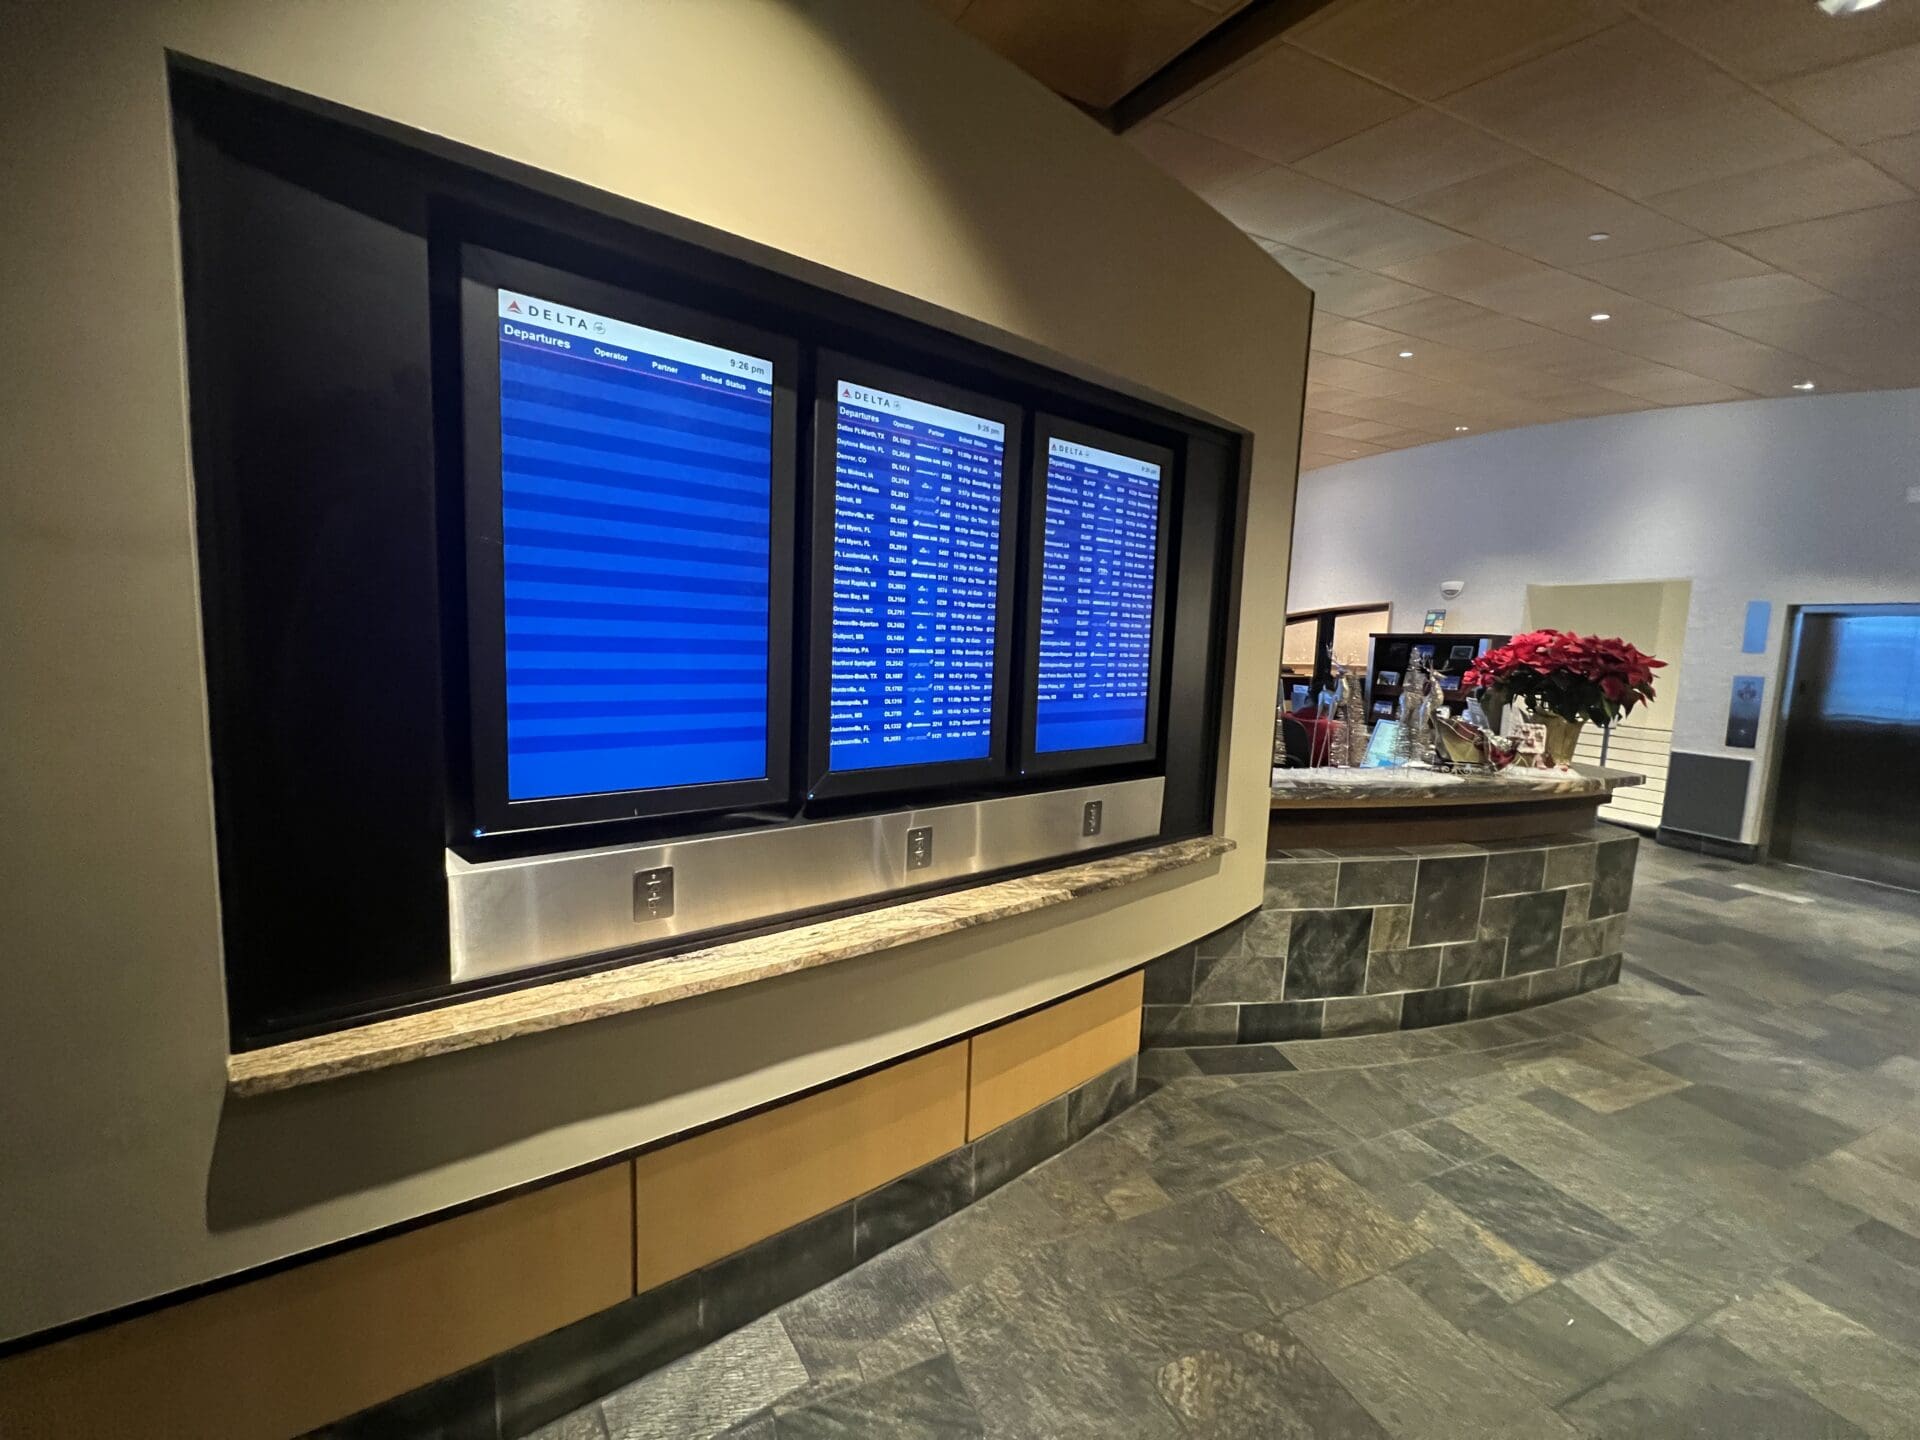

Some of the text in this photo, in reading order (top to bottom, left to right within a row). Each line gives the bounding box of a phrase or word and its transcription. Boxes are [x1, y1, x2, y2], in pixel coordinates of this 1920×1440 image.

[528, 305, 588, 330] DELTA
[504, 324, 571, 350] Departures
[594, 347, 629, 362] Operator
[652, 361, 679, 374] Partner
[730, 358, 765, 376] 9:26 pm
[854, 392, 890, 408] DELTA
[840, 406, 880, 423] Departures
